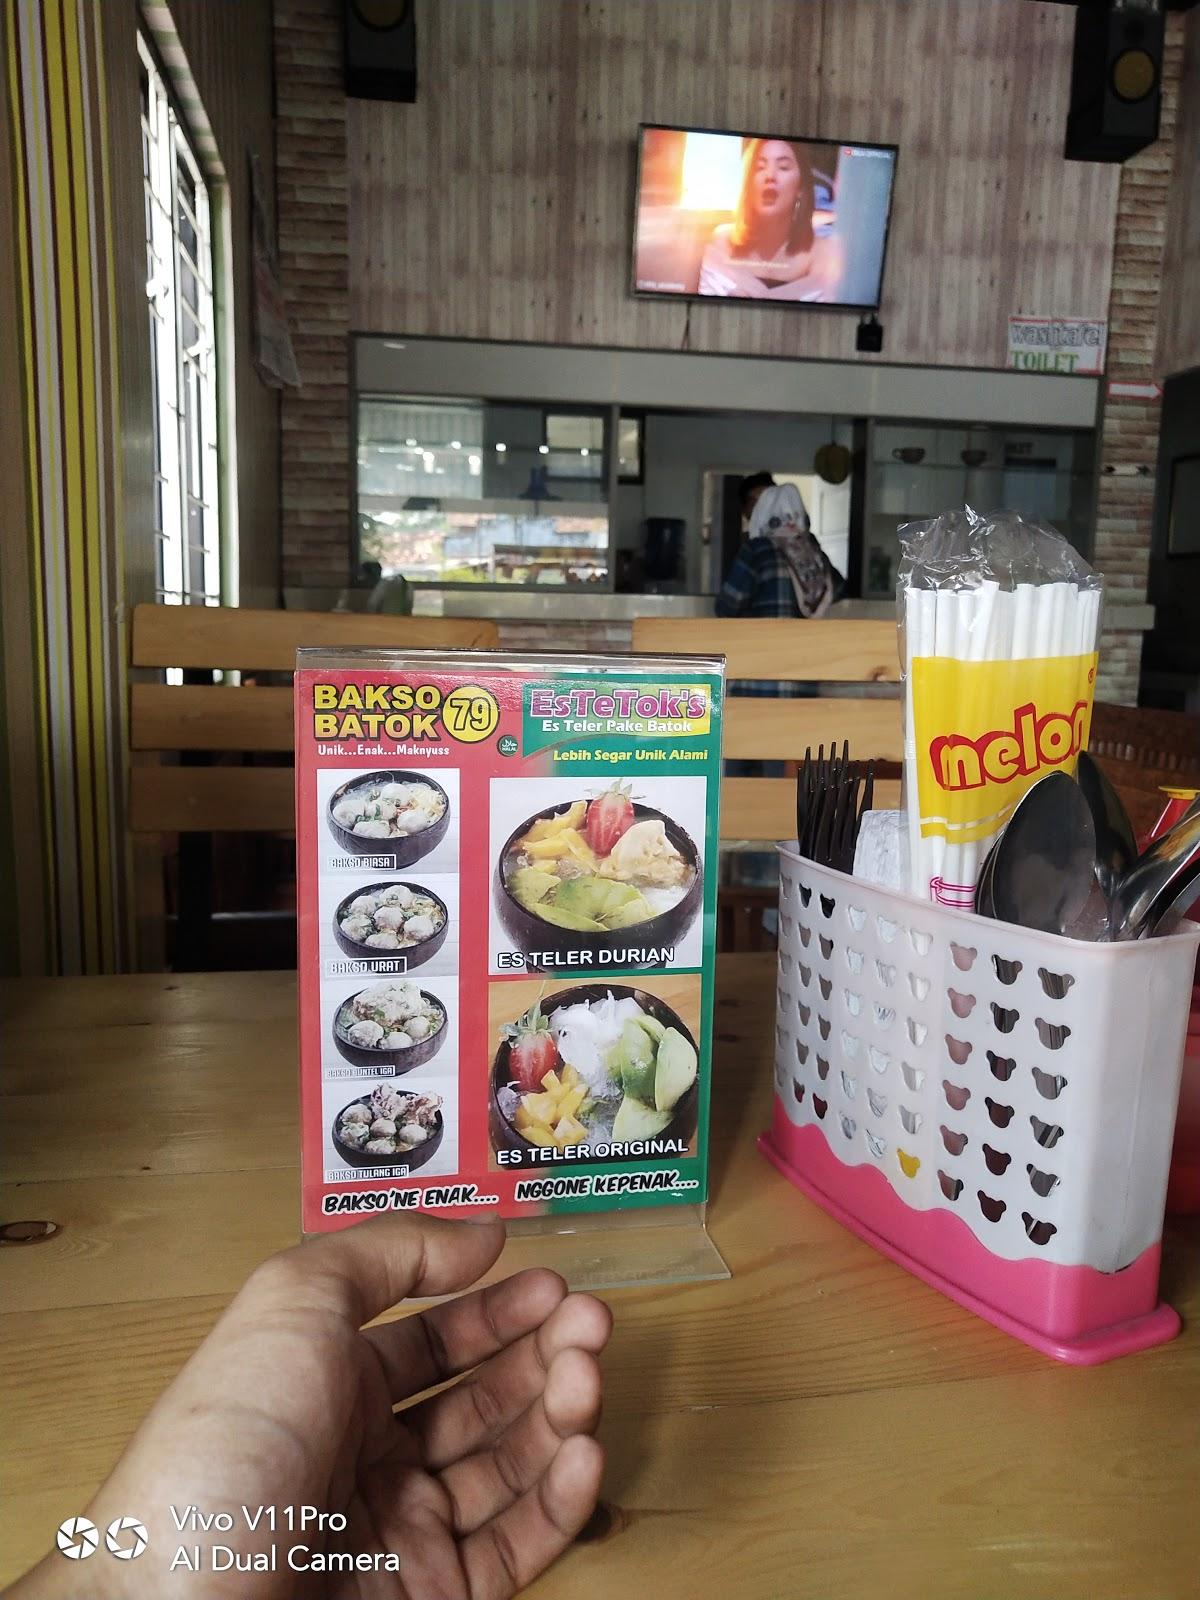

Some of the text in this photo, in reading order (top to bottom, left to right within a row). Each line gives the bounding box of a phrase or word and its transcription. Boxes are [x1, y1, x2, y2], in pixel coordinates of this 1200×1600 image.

[1011, 350, 1080, 373] TOILET
[313, 684, 442, 712] BAKSO
[530, 689, 707, 718] EsTeTok's
[450, 697, 491, 731] 79
[313, 713, 441, 741] BATOK
[542, 720, 692, 732] Es Teler Pake Batok
[553, 749, 708, 763] Lebih Segar Unik Alami
[930, 701, 1088, 791] melon
[331, 857, 390, 867] BAKSO BIASA
[331, 960, 400, 973] BAKSO URAT
[498, 947, 675, 968] ES TELER DURIAN
[380, 1066, 393, 1075] IGA
[497, 1139, 689, 1165] ES TELER ORIGINAL
[328, 1167, 407, 1180] BAKSO TULANG IGA
[517, 1177, 590, 1199] NGGONE
[323, 1189, 420, 1213] BAKSO'NE
